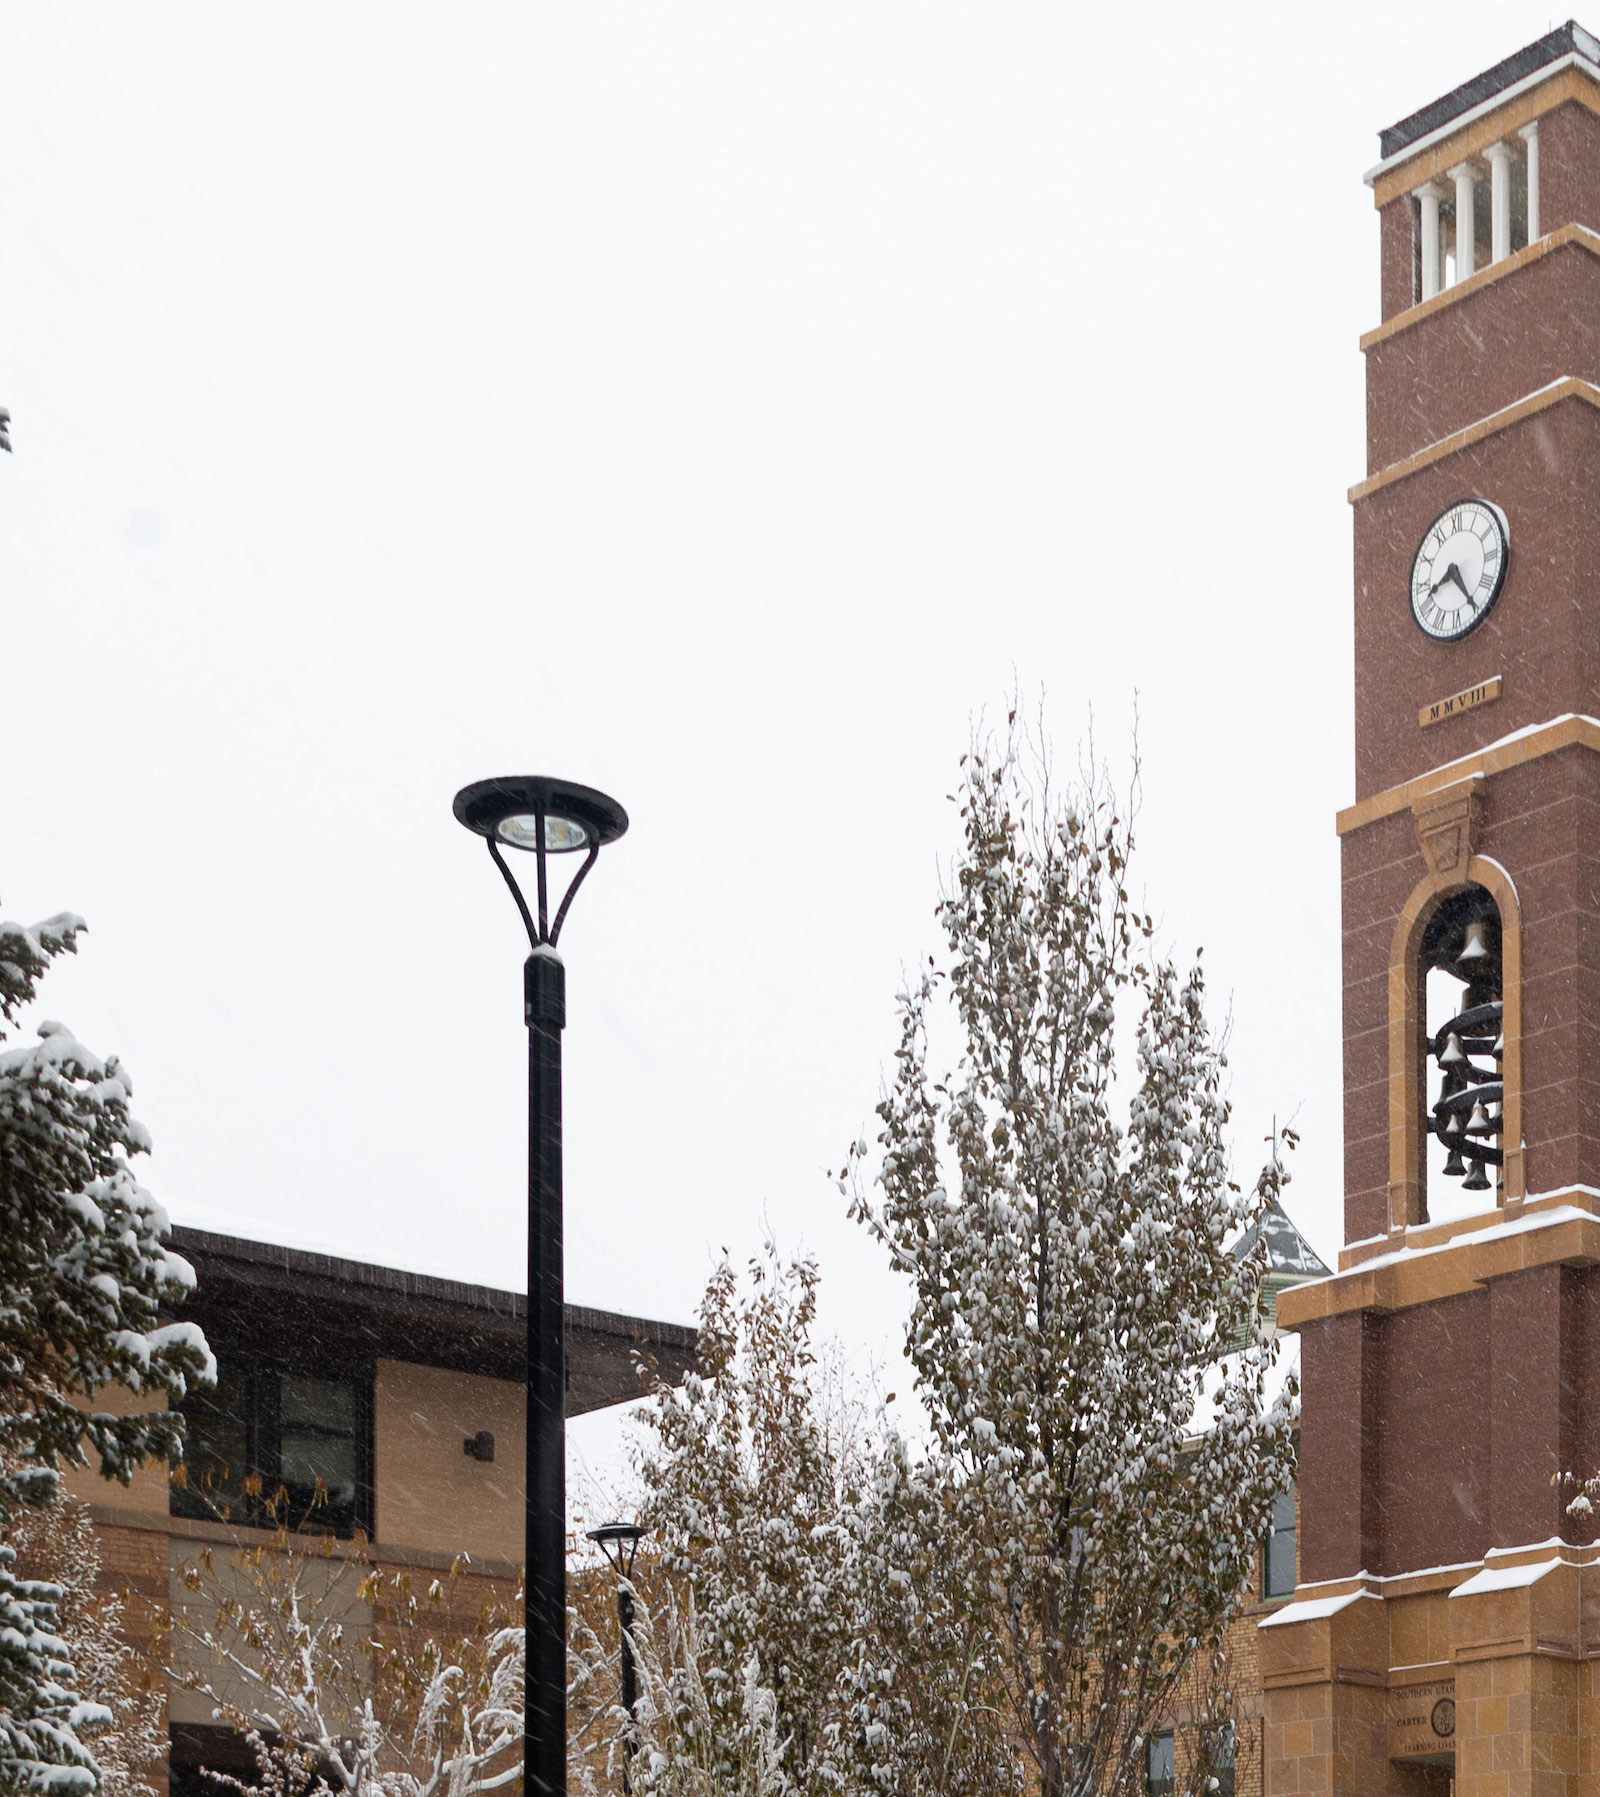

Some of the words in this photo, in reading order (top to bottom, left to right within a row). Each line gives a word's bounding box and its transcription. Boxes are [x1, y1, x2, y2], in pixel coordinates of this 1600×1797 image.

[1430, 686, 1486, 720] MMVIII
[1396, 1687, 1432, 1700] SOUTHERN
[1435, 1684, 1455, 1696] UTAH
[1396, 1715, 1427, 1728] CARTER
[1404, 1743, 1436, 1753] LEARNING
